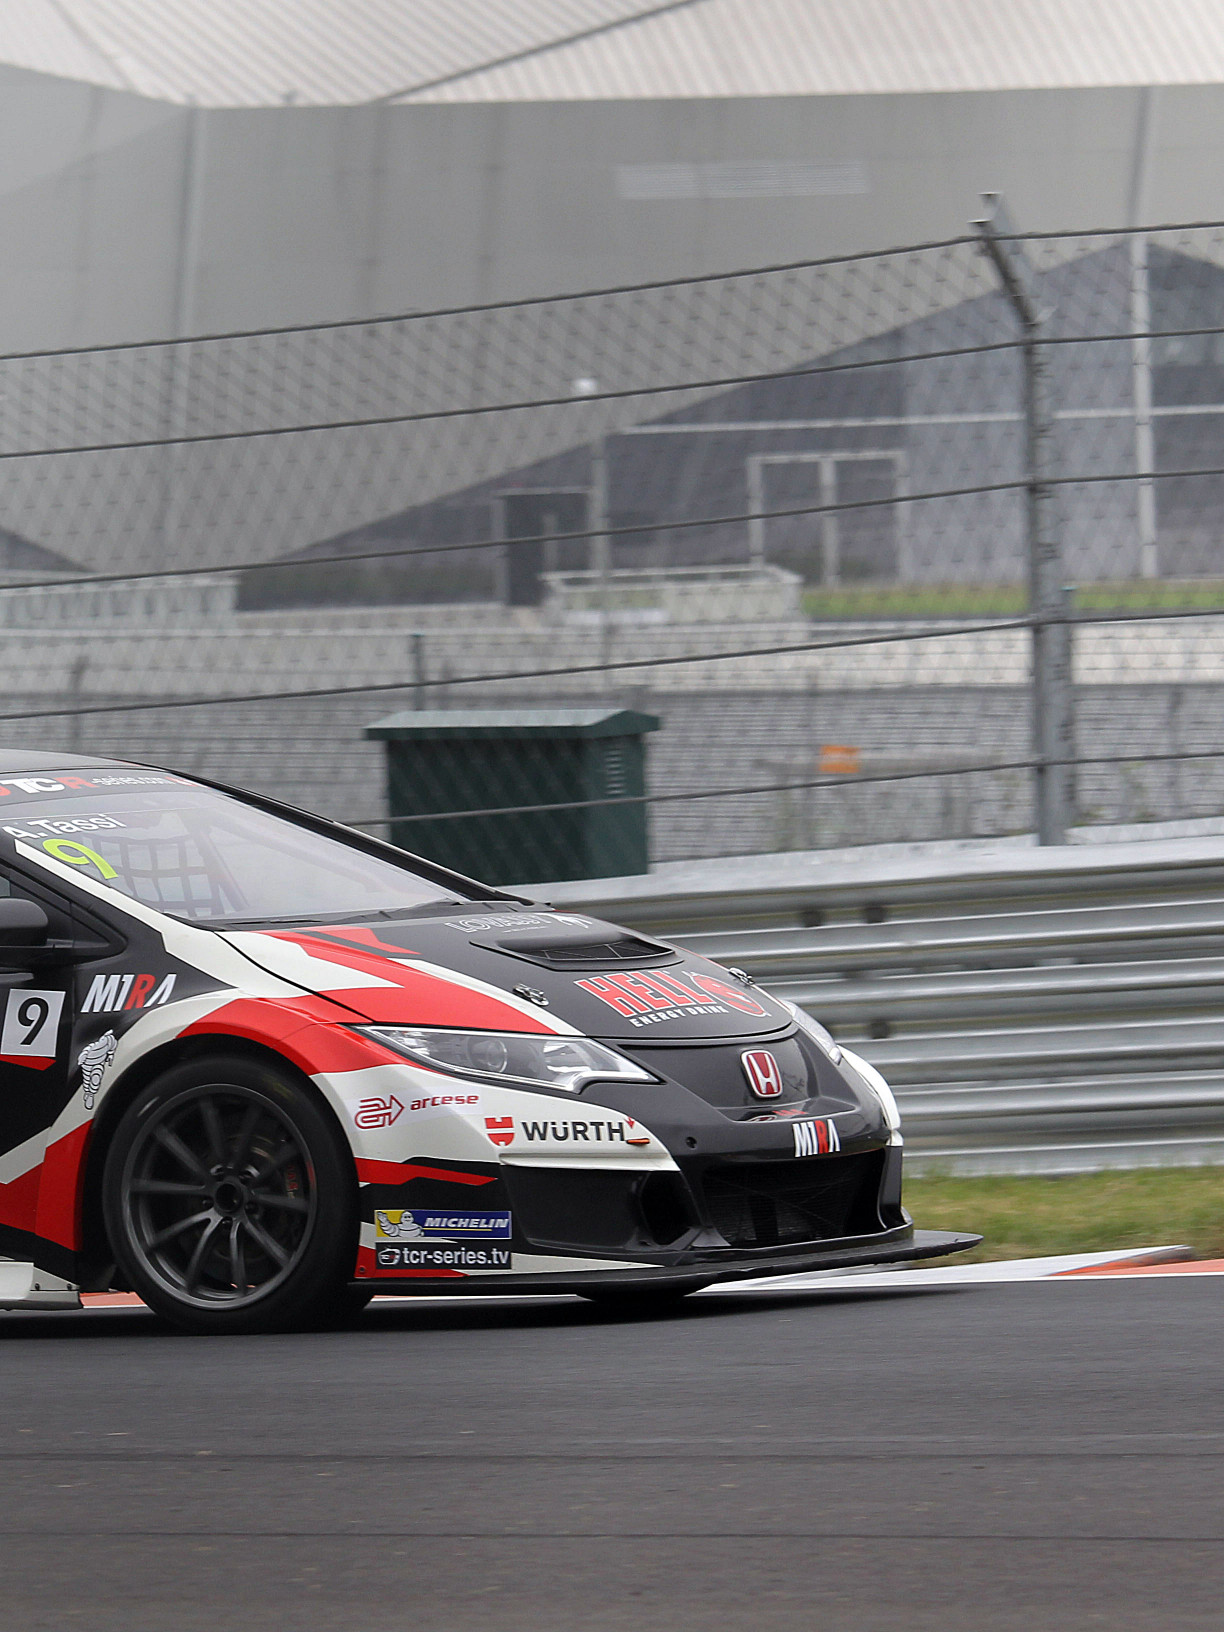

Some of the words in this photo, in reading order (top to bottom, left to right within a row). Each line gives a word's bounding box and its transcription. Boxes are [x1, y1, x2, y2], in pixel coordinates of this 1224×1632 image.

[2, 813, 126, 839] A.Tassi
[42, 838, 118, 880] 9
[573, 970, 718, 1018] HELL
[17, 996, 49, 1046] 9
[629, 1008, 687, 1028] ENERGY
[684, 1004, 729, 1016] DRINK
[410, 1094, 479, 1111] arcese
[521, 1120, 625, 1142] WÜRTH
[424, 1217, 509, 1228] MICHELIN
[402, 1247, 509, 1264] tcr-series.tv
